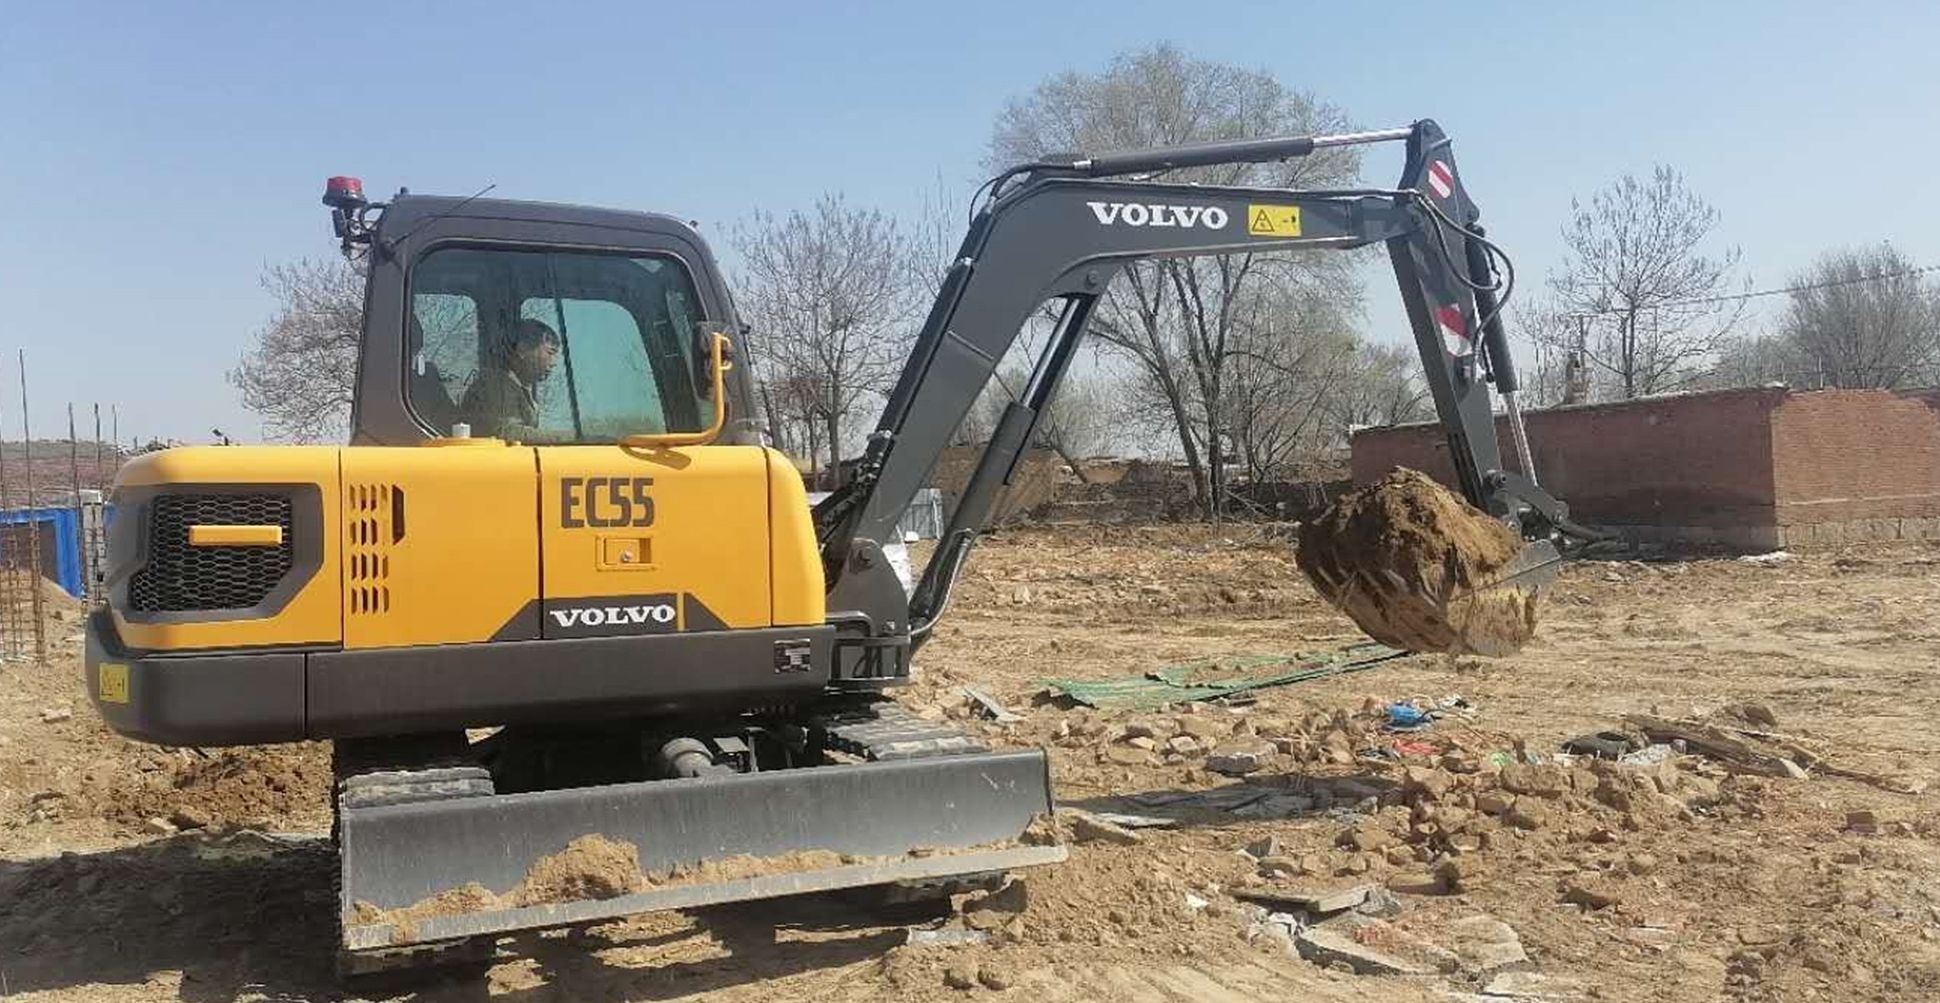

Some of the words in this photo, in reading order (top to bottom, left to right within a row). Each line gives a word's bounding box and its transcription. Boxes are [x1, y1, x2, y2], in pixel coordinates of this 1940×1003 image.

[1086, 201, 1228, 230] VOLVO
[560, 477, 655, 528] EC55
[549, 604, 676, 627] VOLVO
